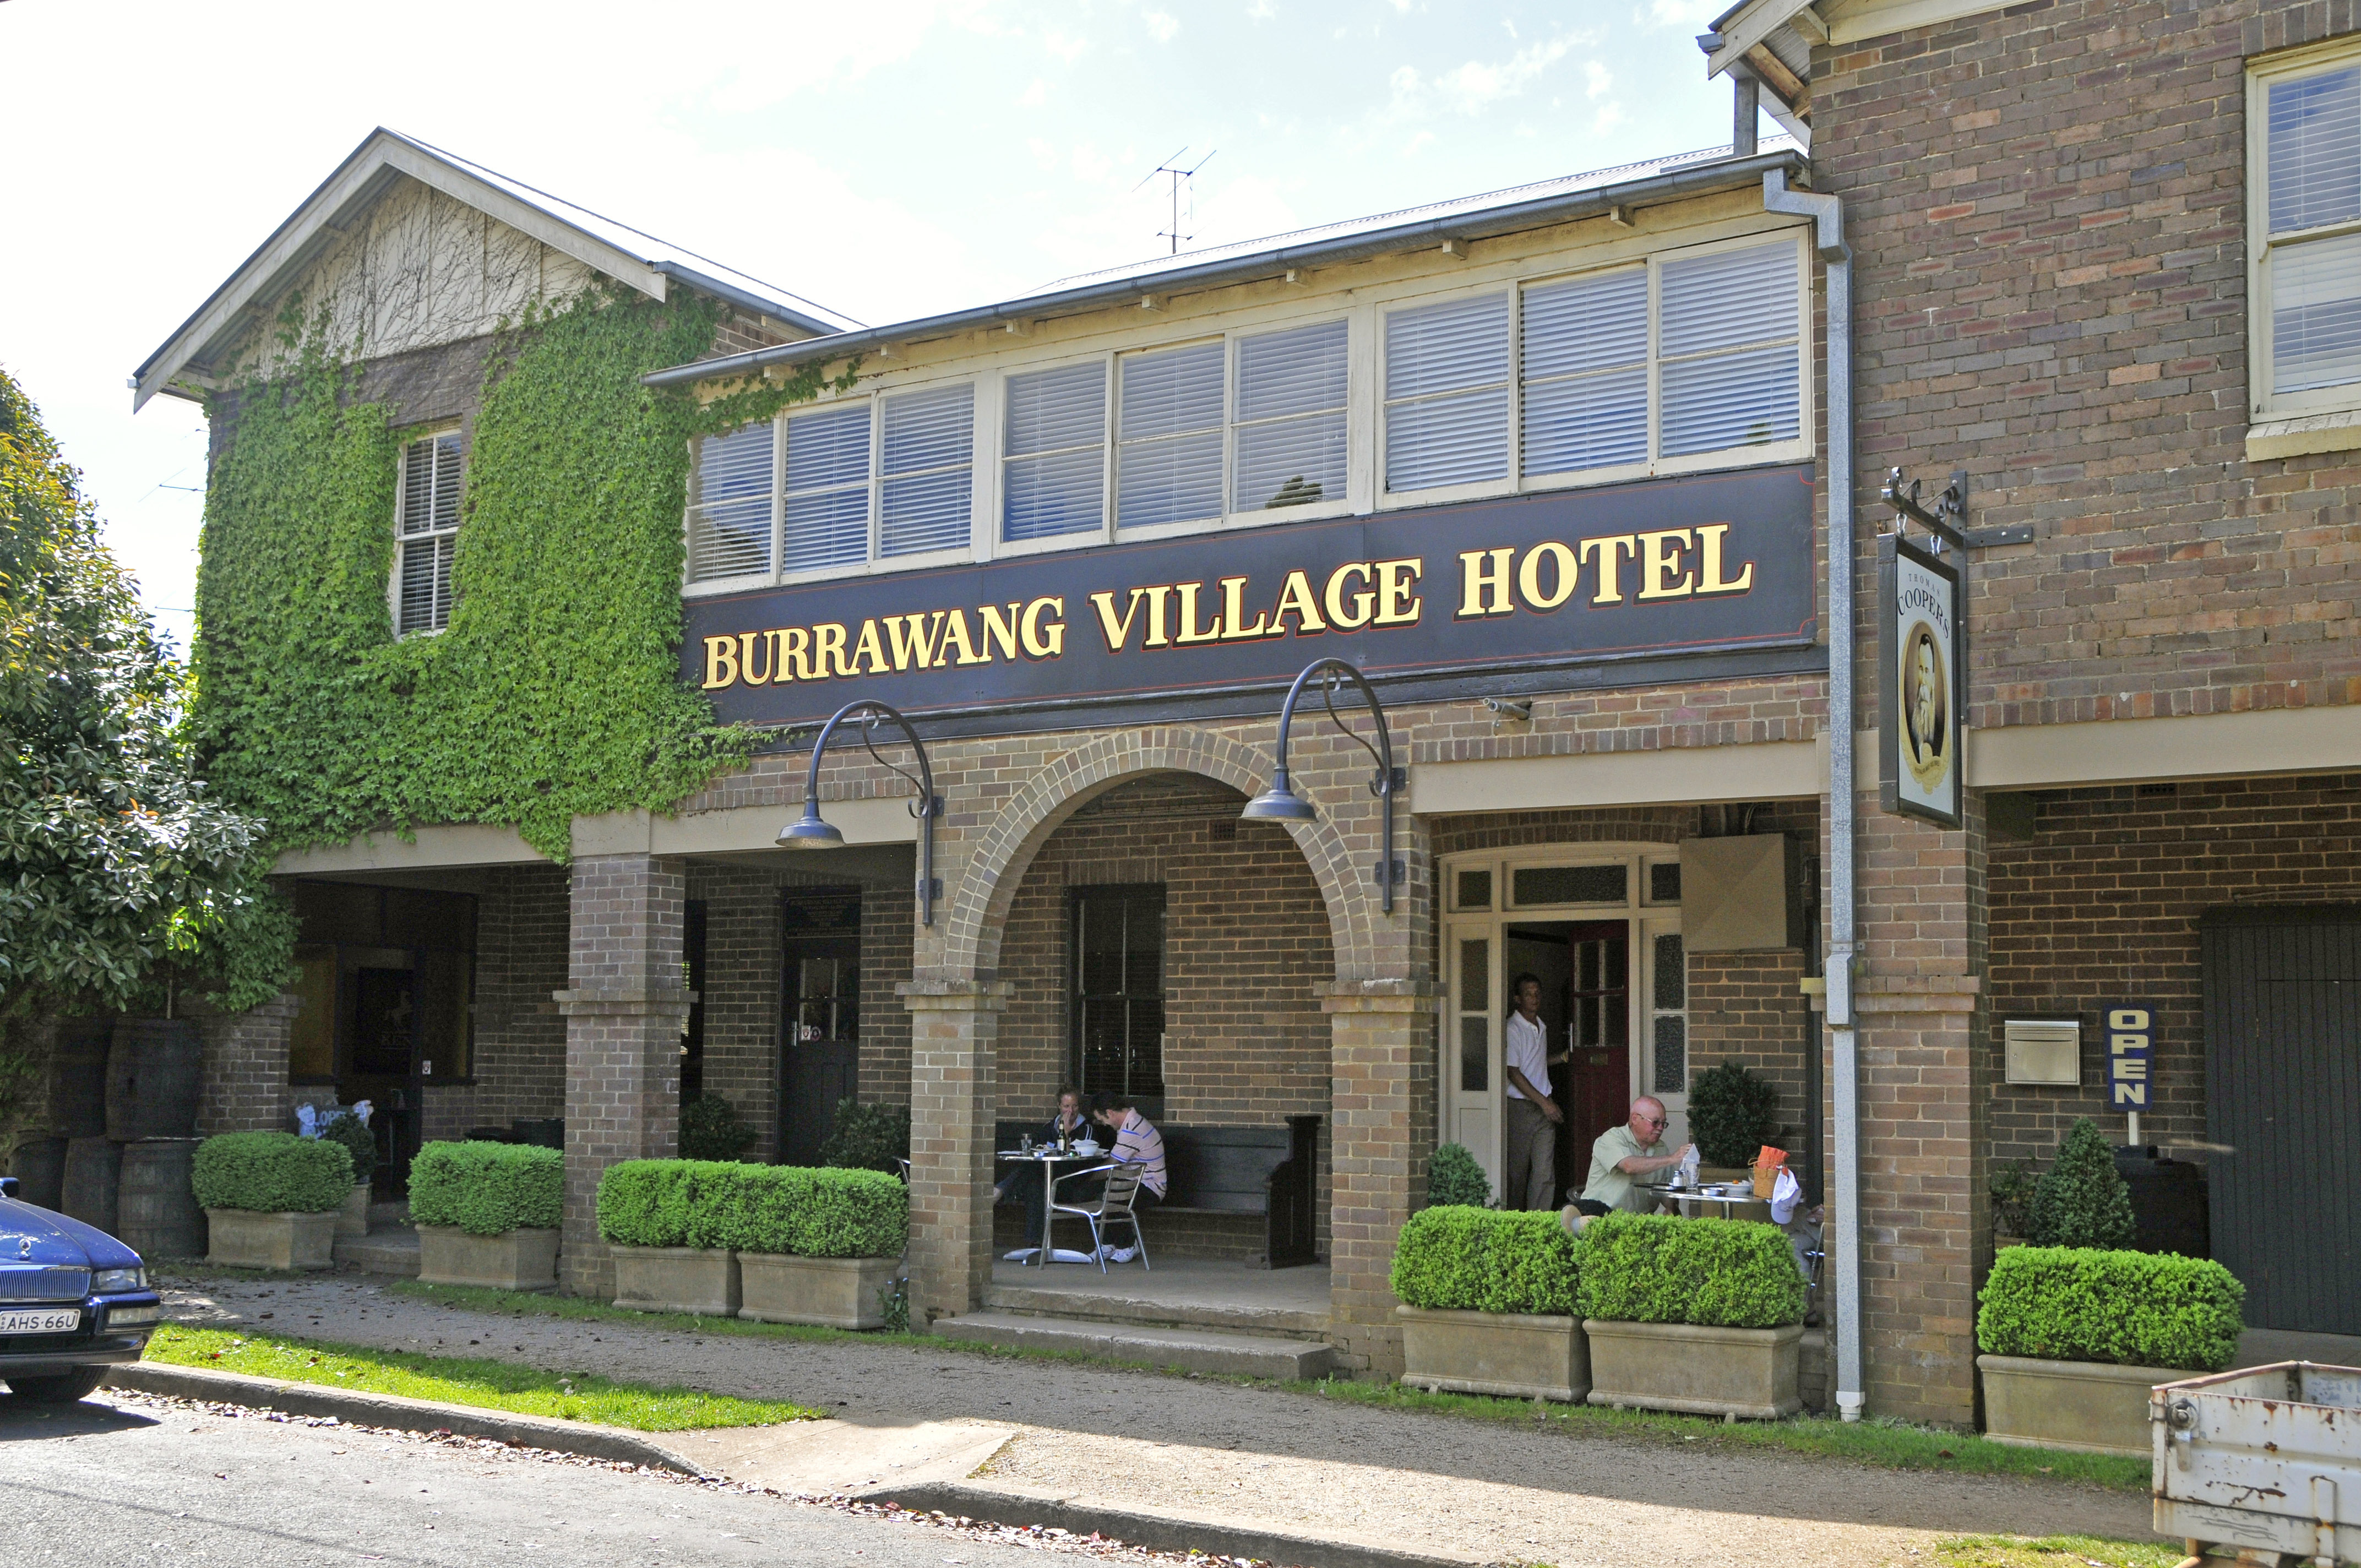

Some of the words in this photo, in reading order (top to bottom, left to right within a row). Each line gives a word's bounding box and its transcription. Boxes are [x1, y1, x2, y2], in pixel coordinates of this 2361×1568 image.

[701, 597, 1065, 689] BURRAWANG
[1090, 558, 1422, 649] VILLAGE
[1458, 524, 1754, 616] HOTEL
[1897, 587, 1950, 639] COOPERS
[1908, 573, 1940, 597] THOMAS
[2109, 1009, 2149, 1104] OPEN
